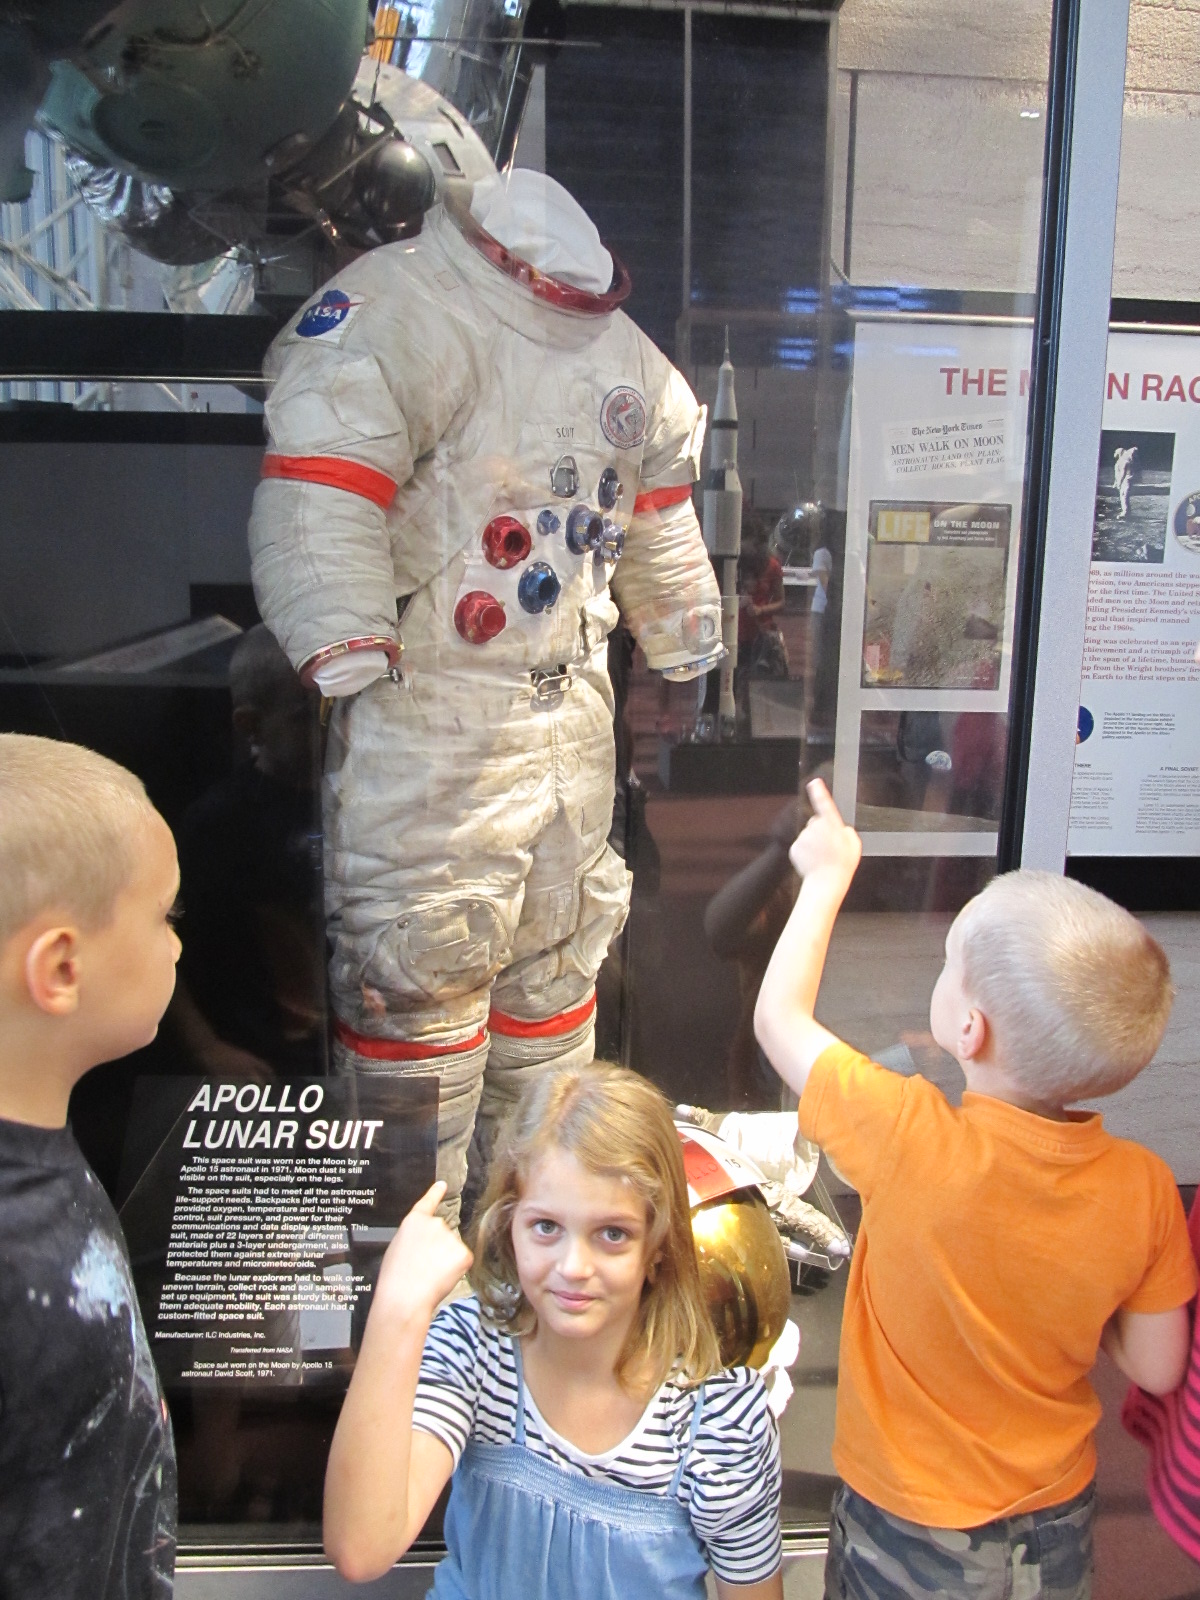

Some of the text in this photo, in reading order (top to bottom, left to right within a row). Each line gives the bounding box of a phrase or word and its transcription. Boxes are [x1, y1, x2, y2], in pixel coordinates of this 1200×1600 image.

[940, 367, 1008, 396] THE
[943, 424, 959, 435] York
[891, 435, 1004, 455] MEN WALK ON MOON
[879, 511, 929, 541] LIFE
[187, 1084, 324, 1113] APOLLO
[182, 1120, 383, 1150] LUNAR SUIT
[255, 1196, 300, 1204] Backpacks
[166, 1260, 222, 1268] temperatures
[190, 1293, 237, 1301] equipment,
[184, 1303, 223, 1311] adequate
[226, 1303, 261, 1311] mobility.
